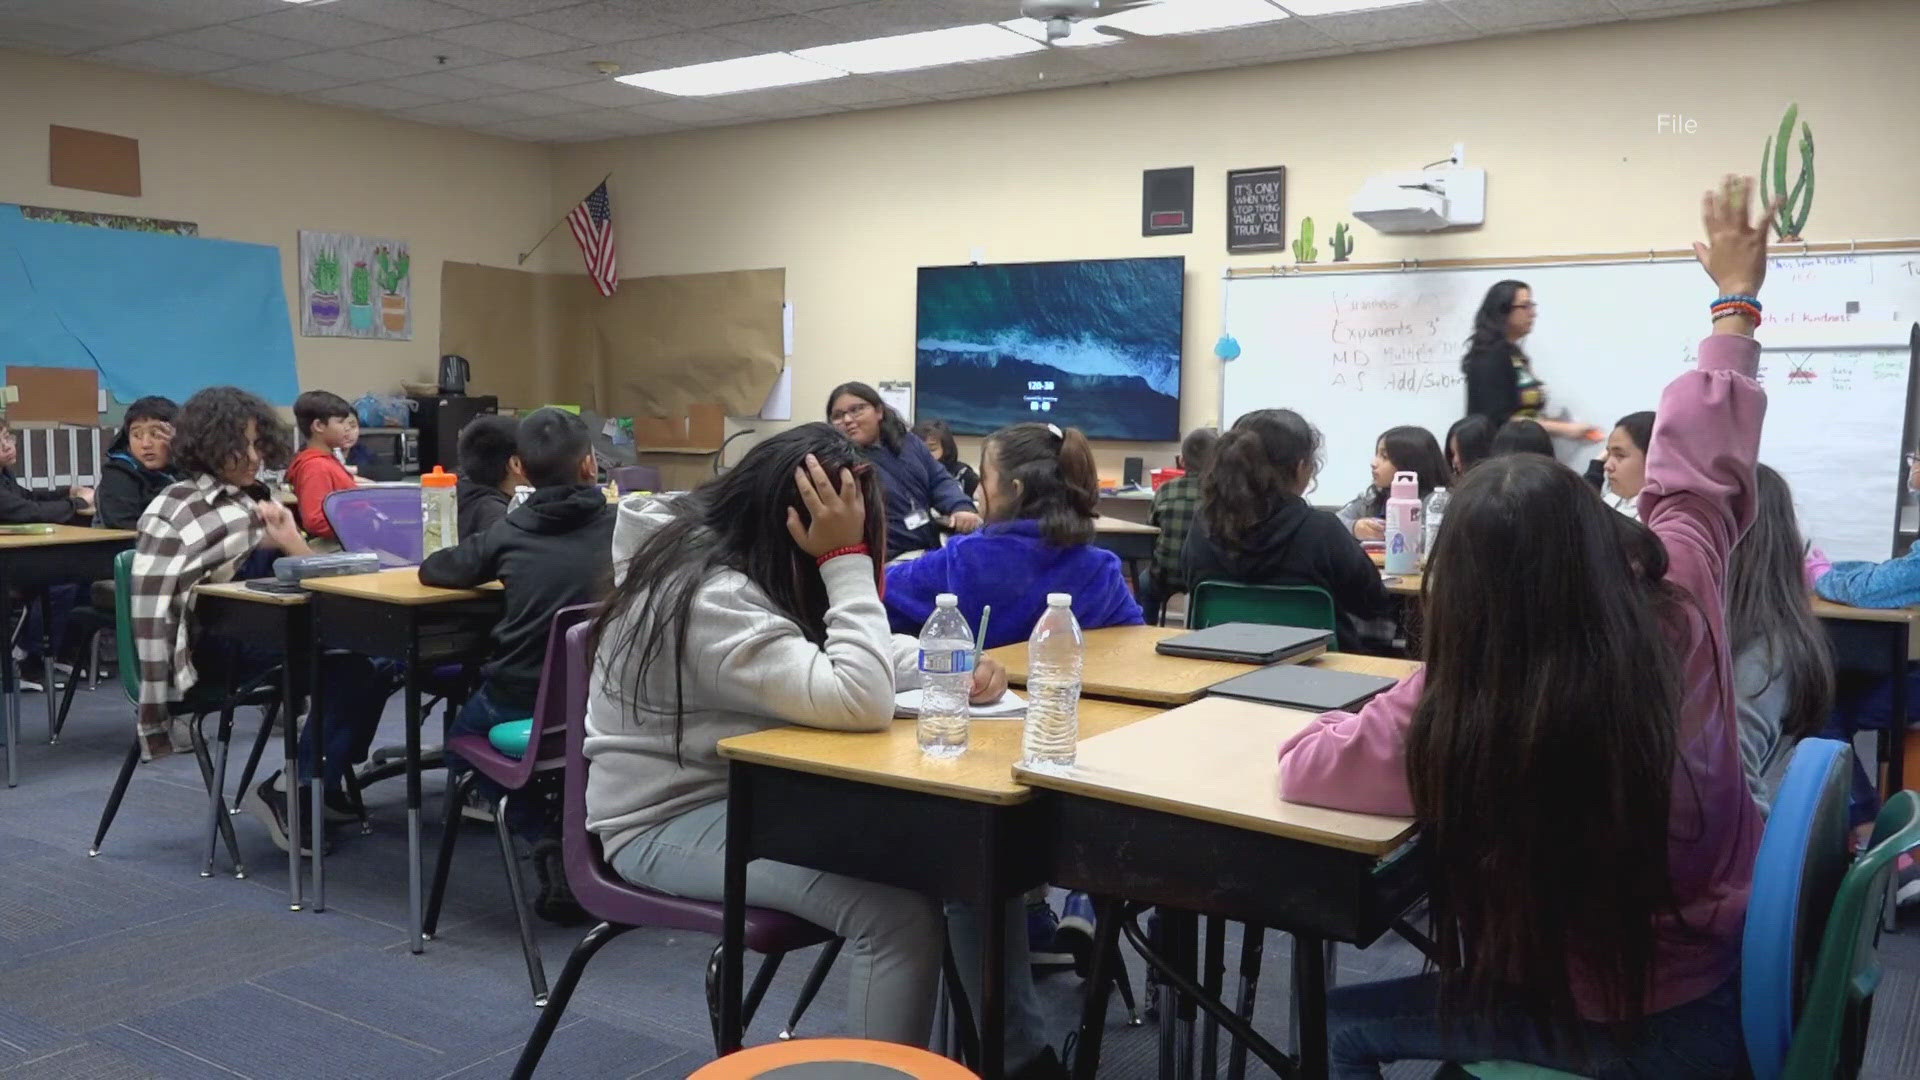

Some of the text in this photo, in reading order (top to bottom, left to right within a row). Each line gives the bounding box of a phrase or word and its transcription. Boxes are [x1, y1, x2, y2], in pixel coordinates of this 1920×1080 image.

[1234, 182, 1279, 196] IT'S ONLY
[1234, 194, 1279, 204] WHEN YOU
[1232, 203, 1280, 215] STOP TRYING
[1233, 212, 1279, 224] THAT YOU
[1233, 223, 1280, 236] TRULY FAIL
[1331, 319, 1413, 344] Exponents
[1353, 349, 1370, 367] D
